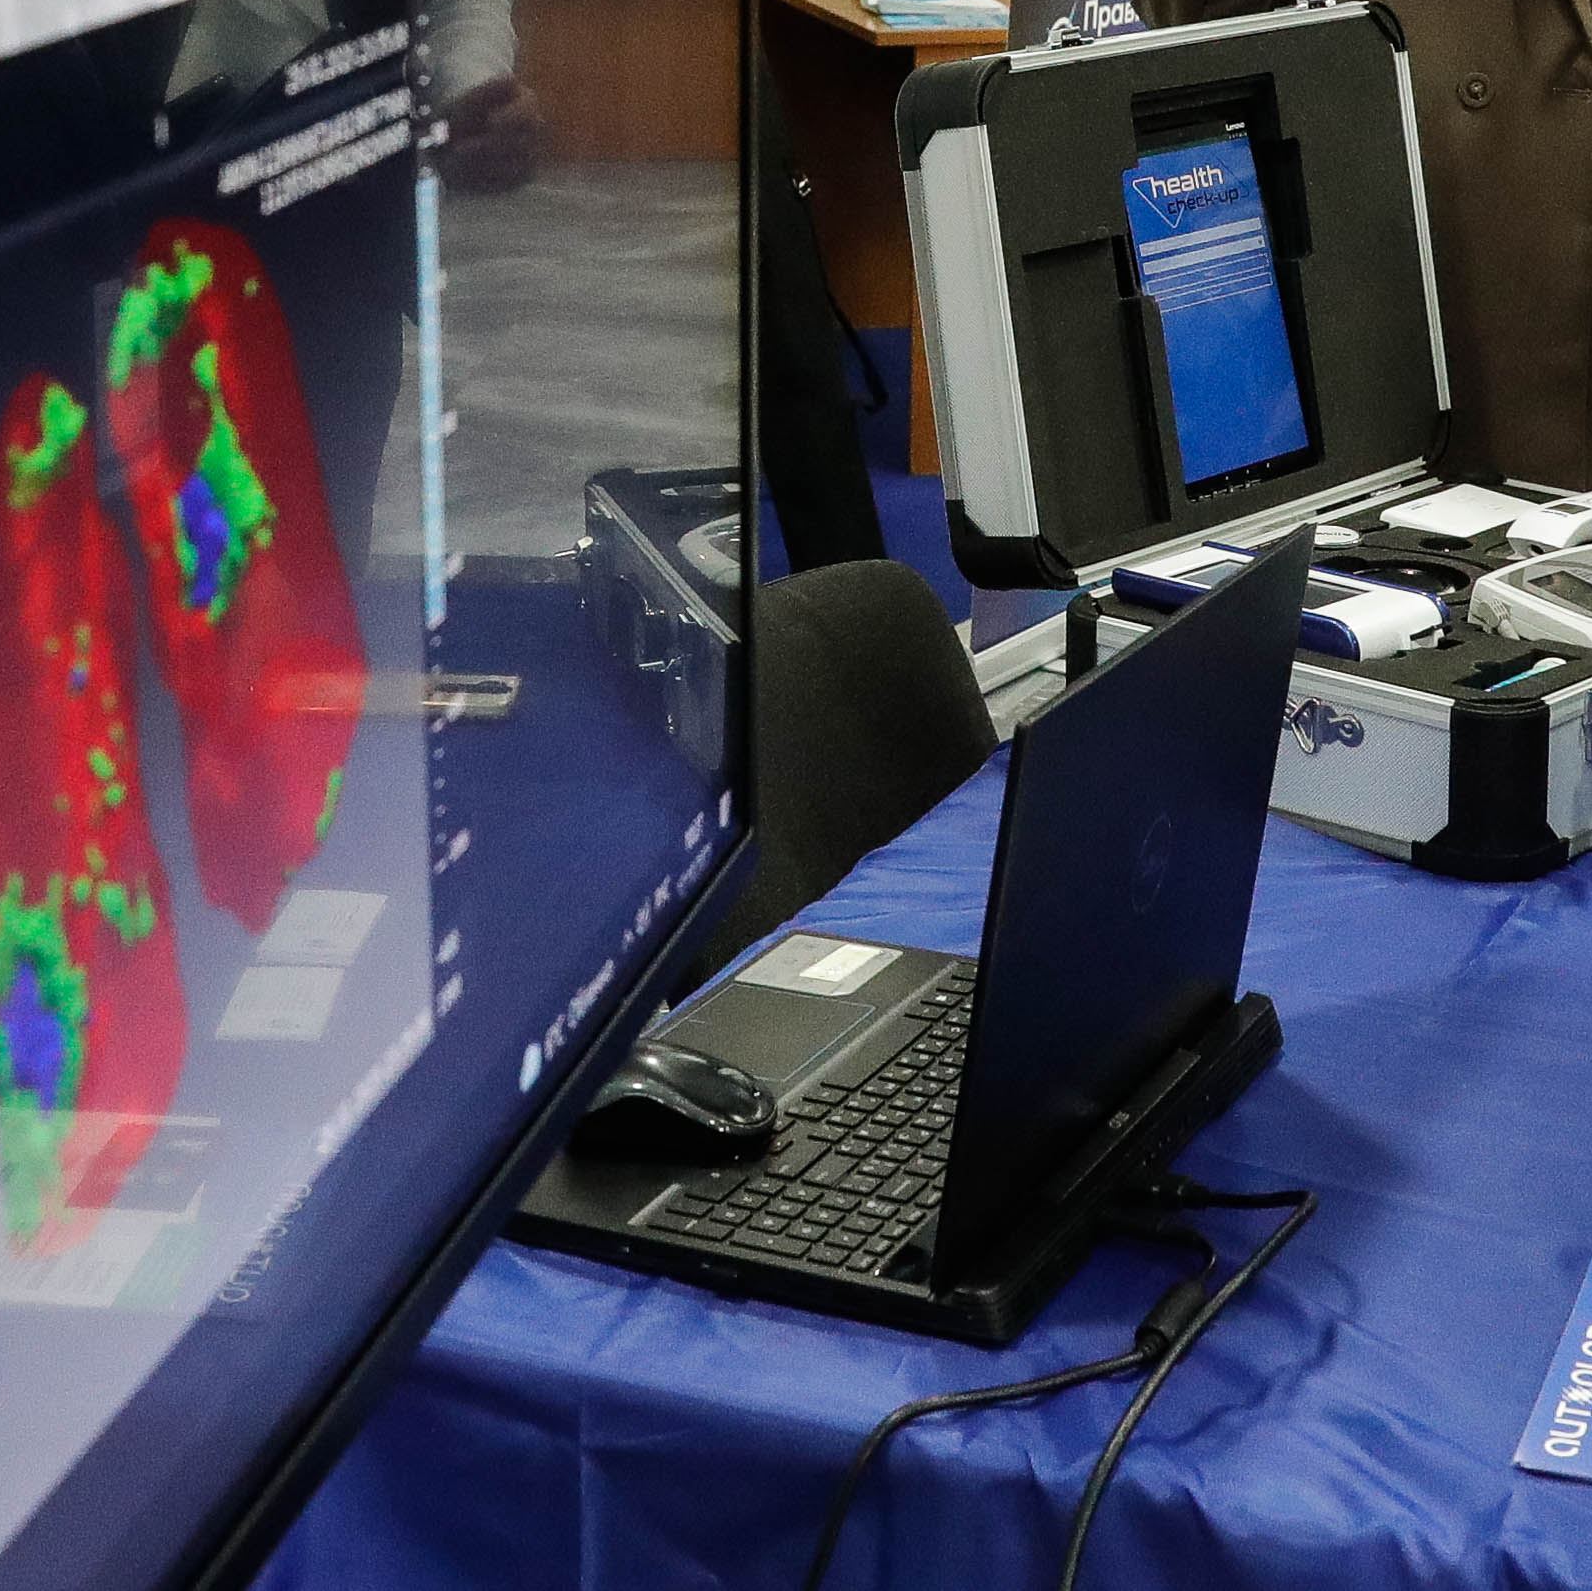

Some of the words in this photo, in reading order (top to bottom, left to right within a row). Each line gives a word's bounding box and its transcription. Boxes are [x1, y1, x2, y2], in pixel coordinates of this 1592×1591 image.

[1083, 0, 1140, 37] Прав
[1150, 165, 1224, 198] health
[1167, 188, 1239, 214] check-up
